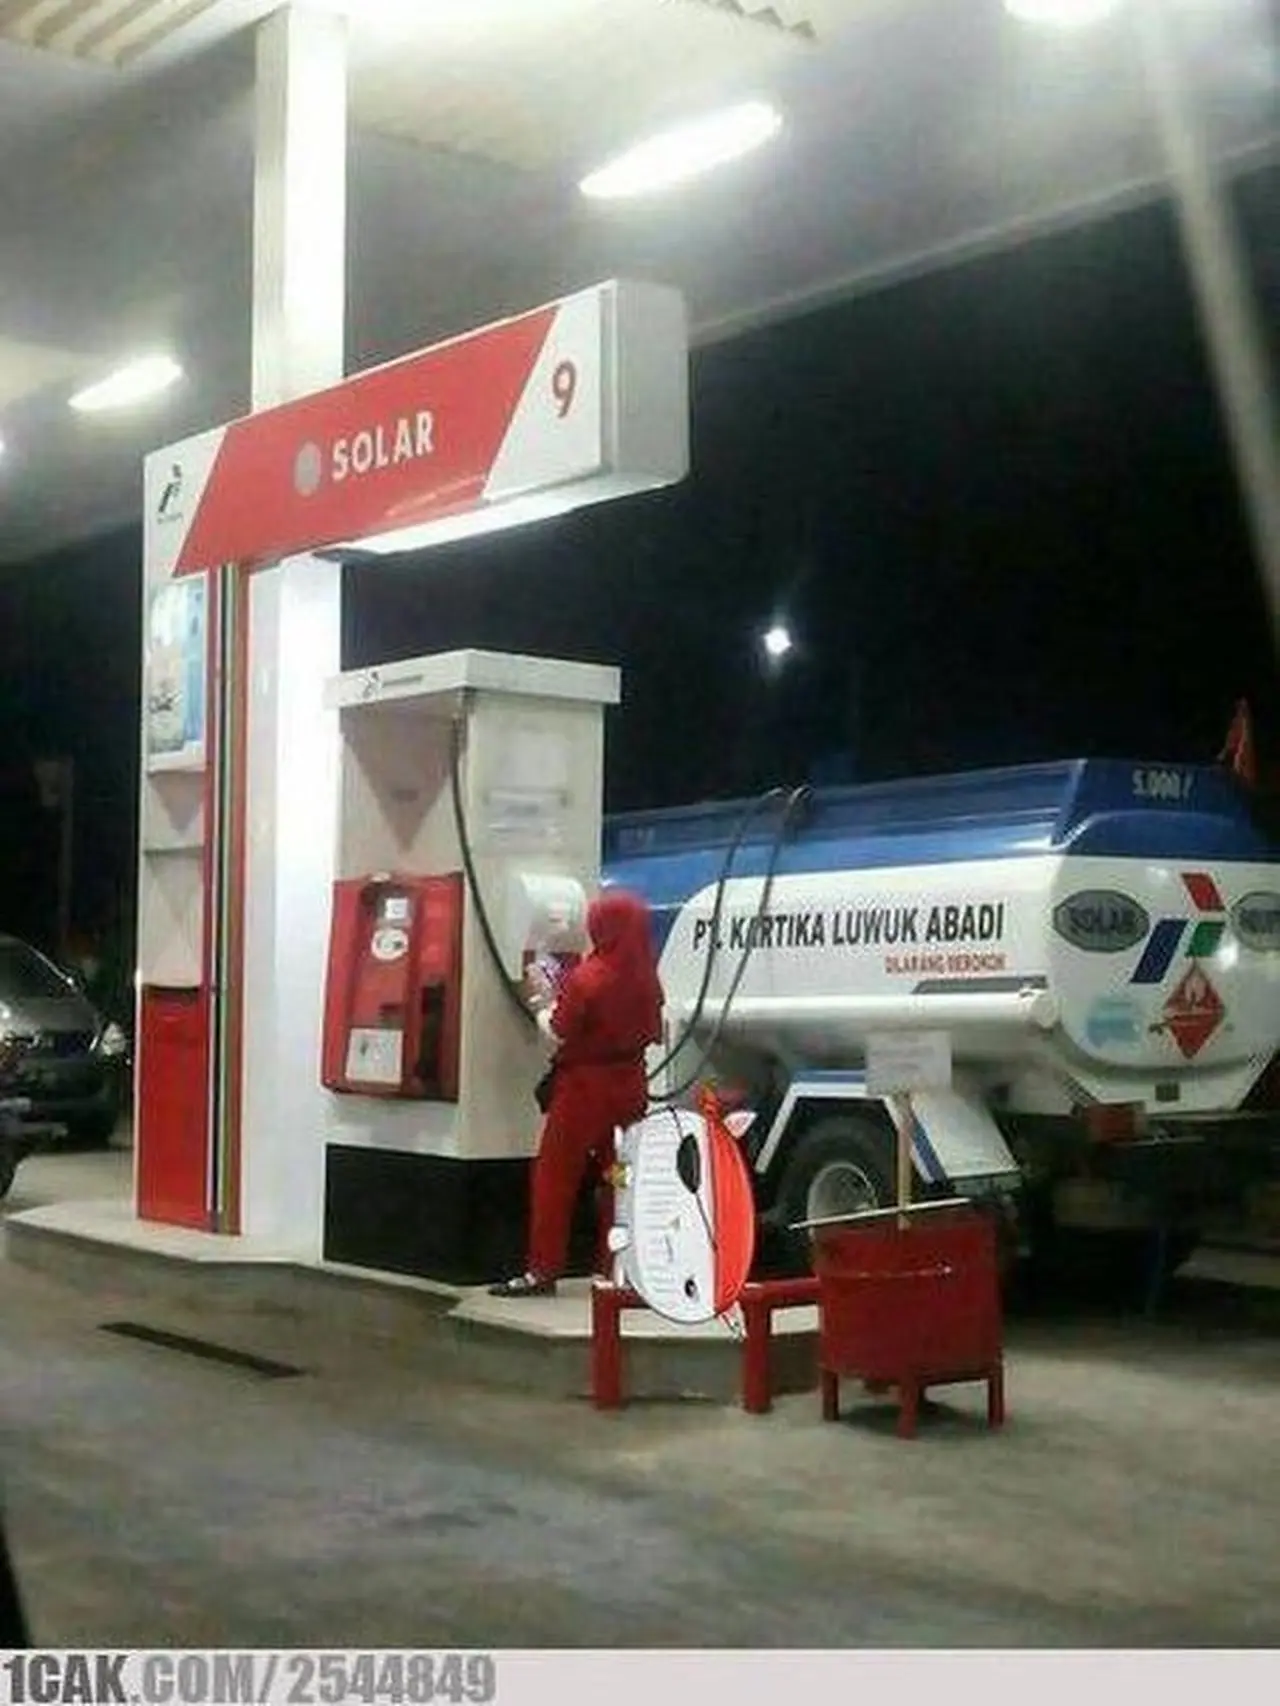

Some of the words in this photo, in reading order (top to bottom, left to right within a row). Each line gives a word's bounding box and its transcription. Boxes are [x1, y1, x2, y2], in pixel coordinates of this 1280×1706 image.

[553, 360, 577, 418] 9
[333, 411, 434, 481] SOLAR
[730, 912, 825, 948] KARTIKA
[832, 905, 919, 944] LUWUK
[926, 902, 1004, 940] ABADI
